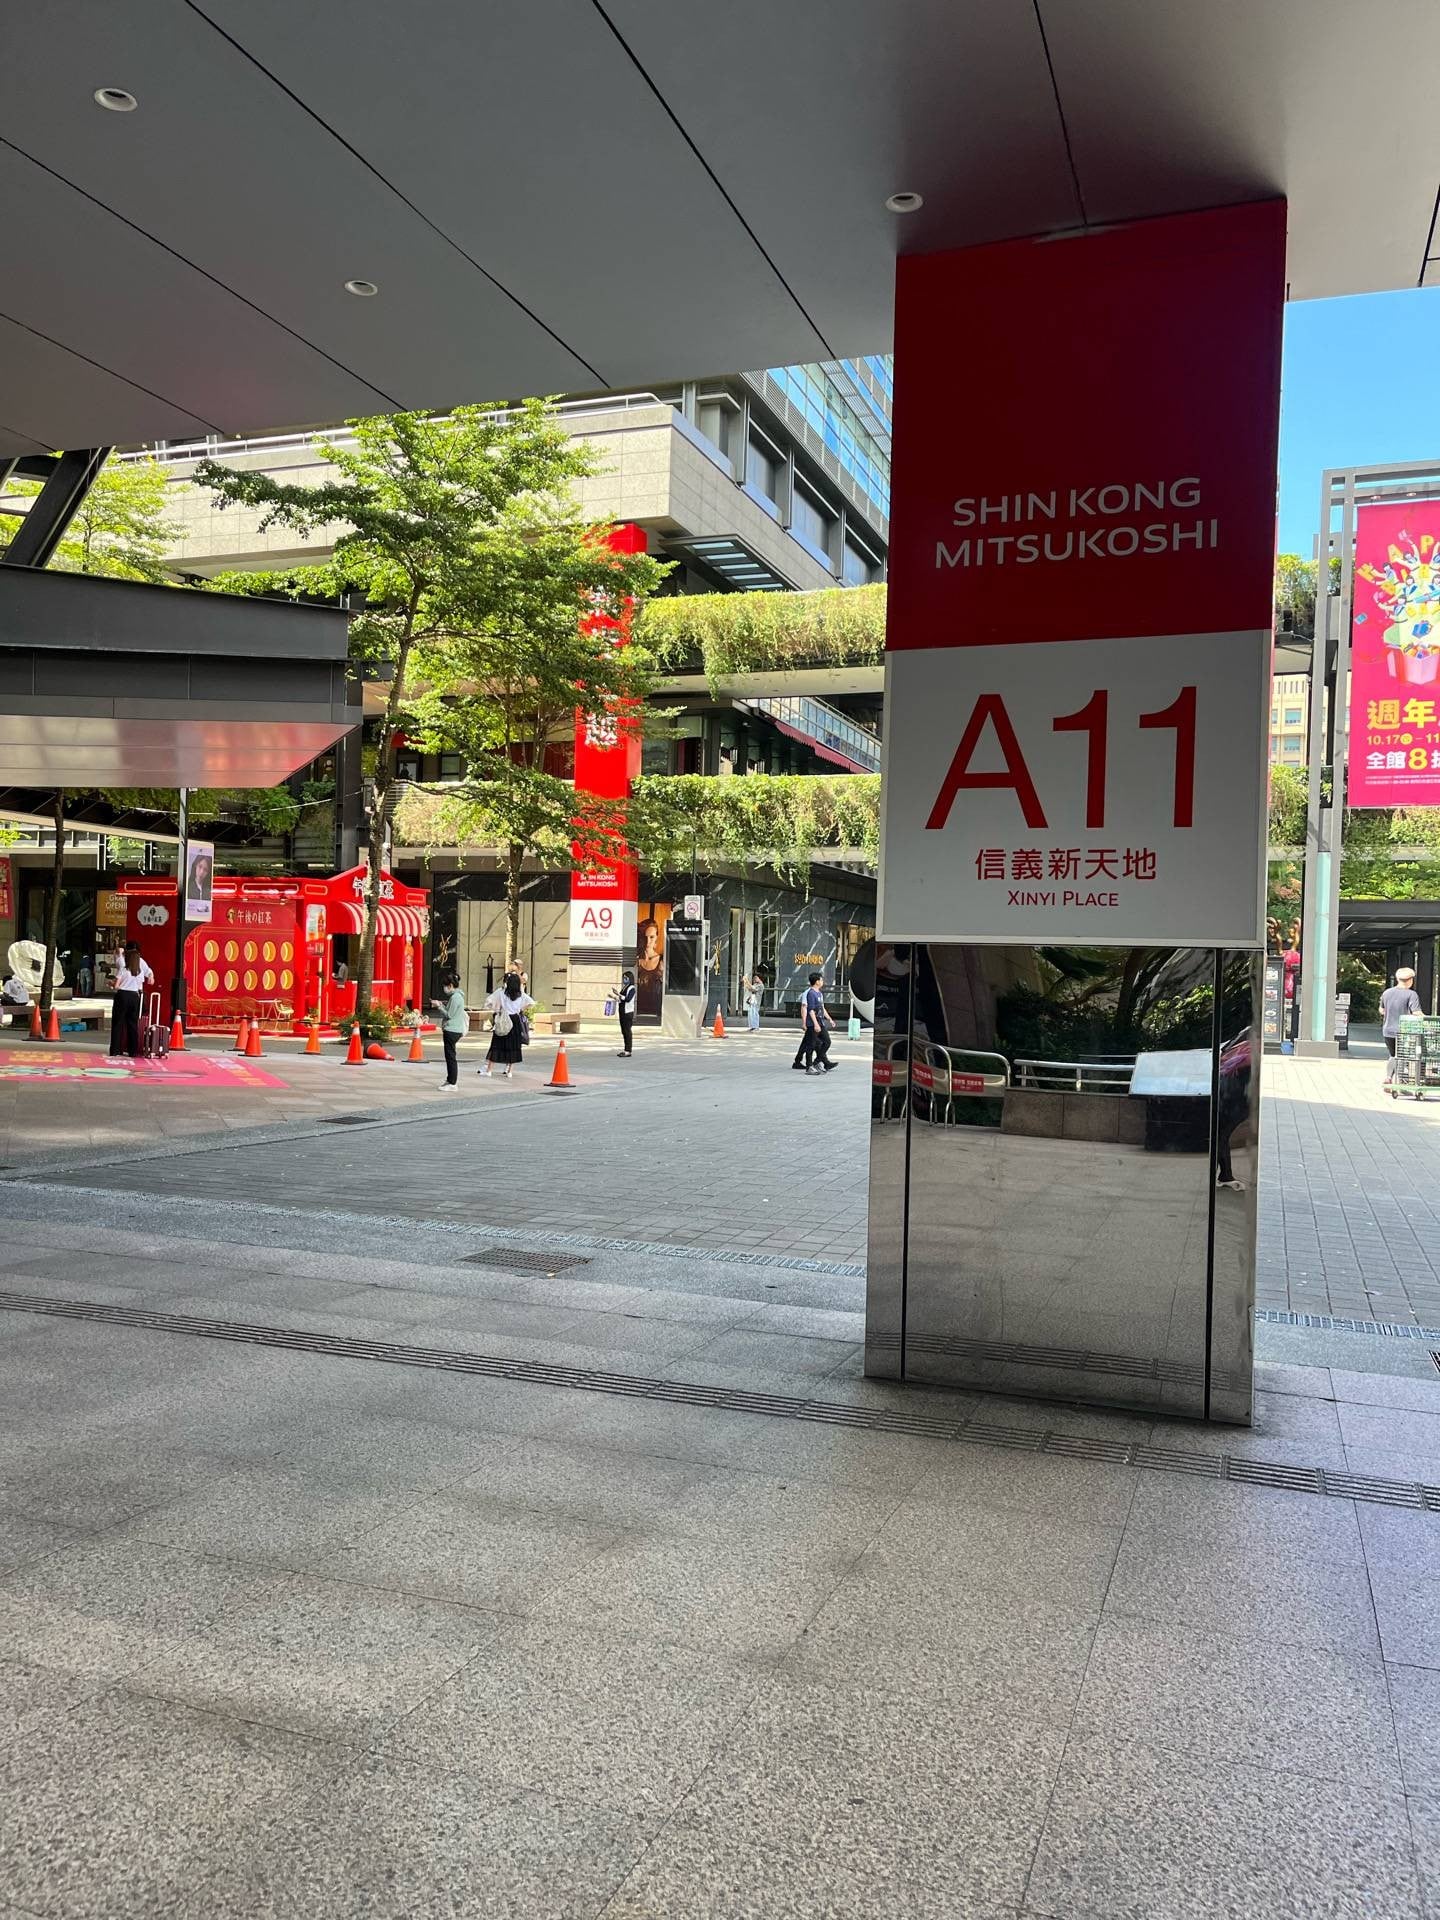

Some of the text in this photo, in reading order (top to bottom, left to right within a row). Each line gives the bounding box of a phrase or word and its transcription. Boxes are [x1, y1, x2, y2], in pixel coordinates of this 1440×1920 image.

[952, 477, 1202, 527] SHIN KONG
[934, 518, 1219, 569] MITSUKOSHI
[924, 685, 1198, 831] A11
[974, 846, 1157, 882] 信義新天地
[580, 906, 613, 930] A9
[1006, 889, 1120, 908] XINYI PLACE
